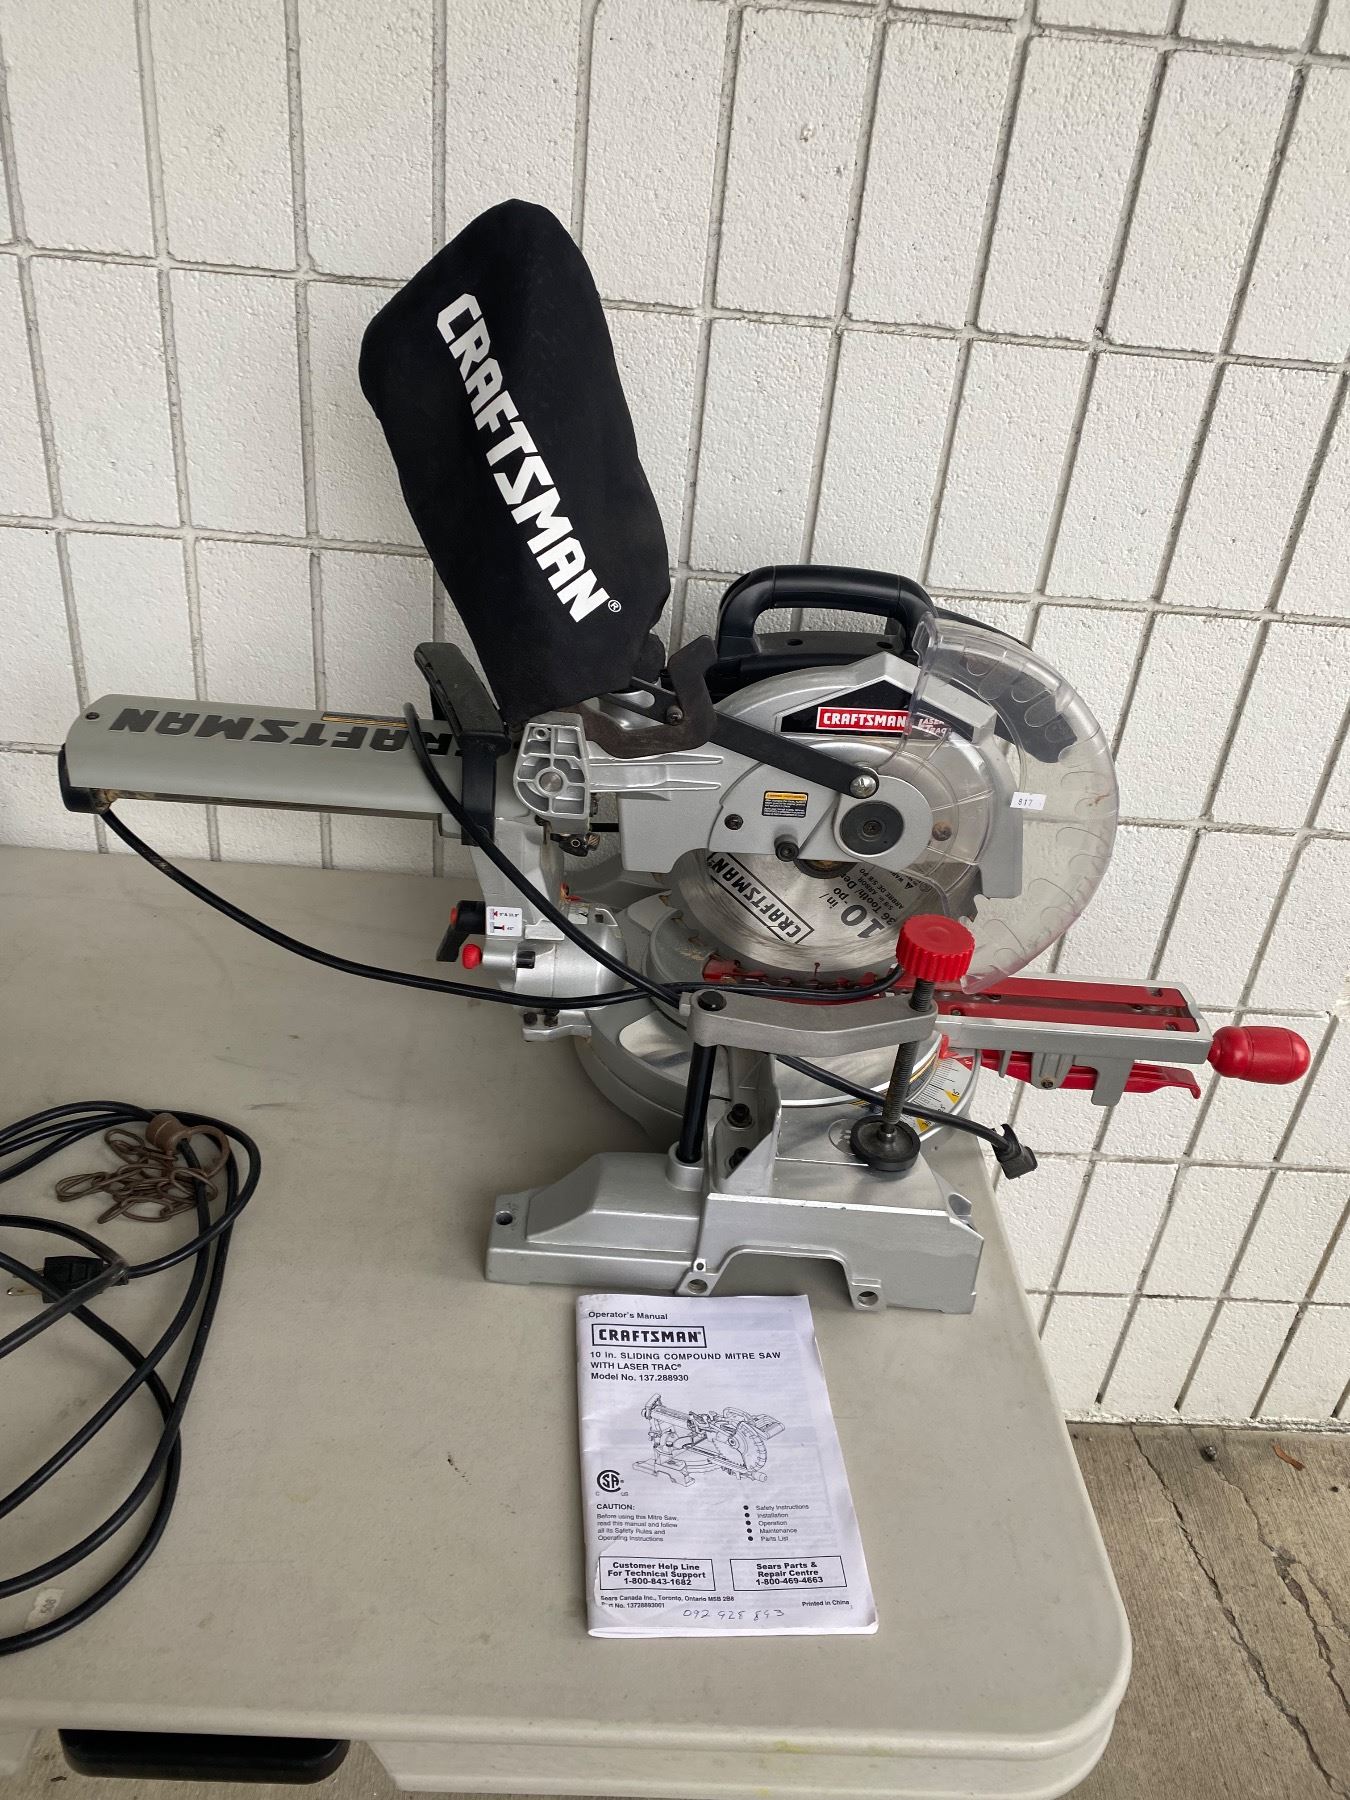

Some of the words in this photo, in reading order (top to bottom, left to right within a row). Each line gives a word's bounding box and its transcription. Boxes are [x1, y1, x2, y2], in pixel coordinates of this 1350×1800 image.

[823, 712, 907, 728] CRAFTSMAN
[712, 858, 802, 938] CRAFTSMAN
[841, 904, 885, 938] 10
[881, 912, 897, 926] 36
[588, 1311, 635, 1319] Operator's
[637, 1312, 668, 1320] Manual
[620, 1352, 660, 1360] SLIDING
[725, 1352, 755, 1360] MITRE
[759, 1351, 781, 1359] SAW
[596, 1503, 635, 1511] CAUTION:
[612, 1561, 656, 1570] Customer
[658, 1562, 679, 1571] Help
[681, 1563, 700, 1571] Line
[625, 1569, 668, 1577] Technical
[671, 1570, 706, 1579] Support
[623, 1577, 692, 1586] 1-800-843-1682
[755, 1576, 824, 1585] 1-800-469-4663
